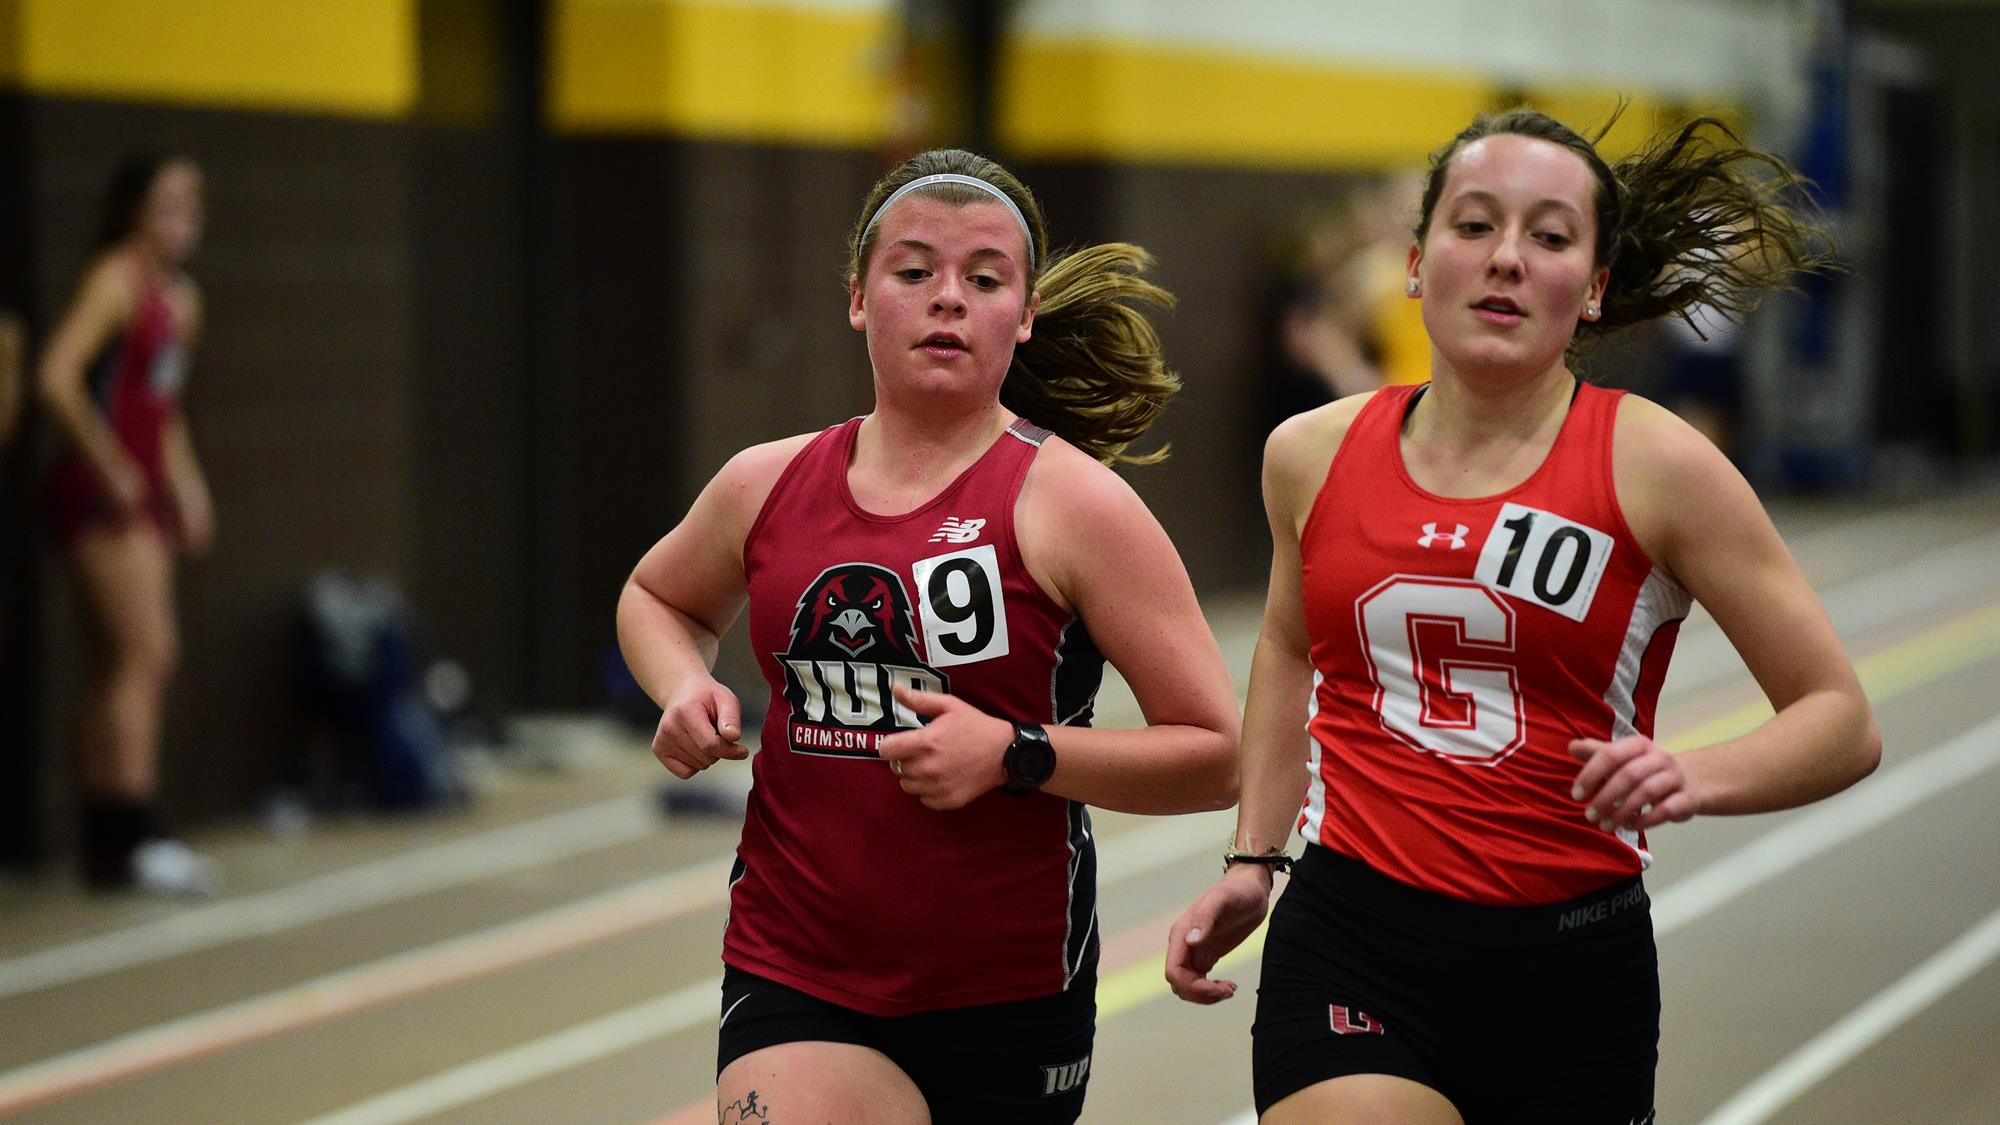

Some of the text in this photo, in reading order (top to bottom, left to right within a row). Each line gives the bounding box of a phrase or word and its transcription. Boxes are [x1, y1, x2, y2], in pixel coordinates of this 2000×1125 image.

[1495, 511, 1592, 606] 10
[927, 557, 995, 656] 9
[1354, 573, 1526, 767] G
[795, 726, 867, 750] CRIMSON
[1558, 883, 1647, 931] NIKE PRO
[1045, 1056, 1089, 1094] IUP
